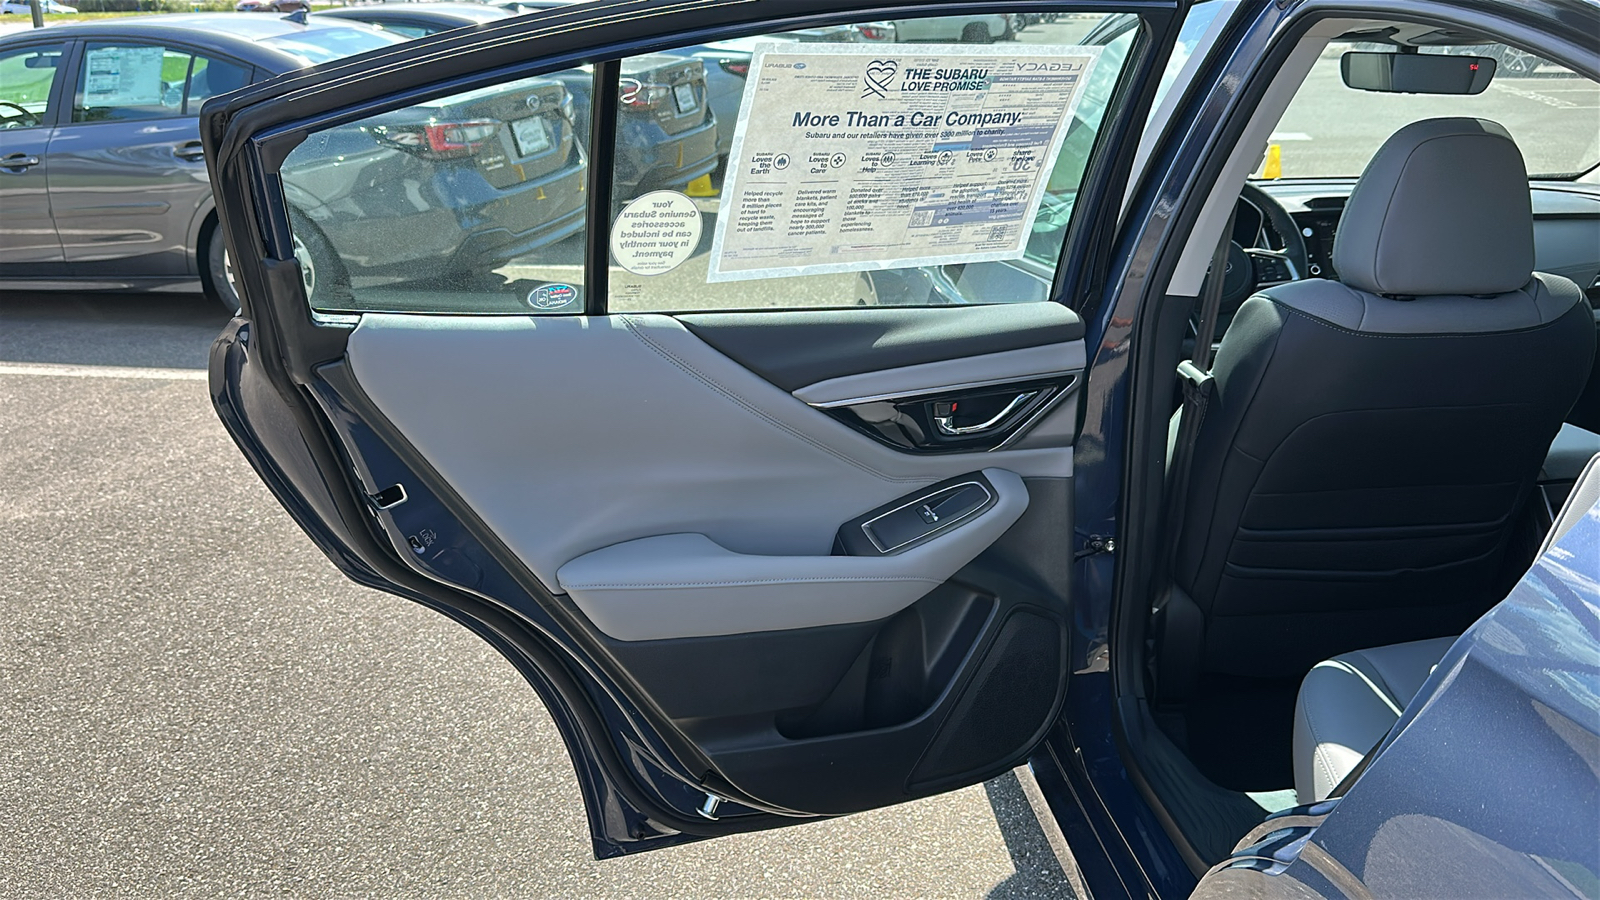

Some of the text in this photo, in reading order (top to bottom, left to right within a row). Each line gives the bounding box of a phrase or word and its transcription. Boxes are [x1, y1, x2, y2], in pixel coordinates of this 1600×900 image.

[906, 68, 988, 80] THE SUBARU
[901, 81, 984, 91] LOVE PROMISE
[792, 112, 840, 127] More
[846, 111, 889, 127] Than
[894, 115, 905, 127] a
[910, 112, 942, 127] Car
[946, 112, 1022, 127] Company.
[420, 529, 434, 546] LOCK
